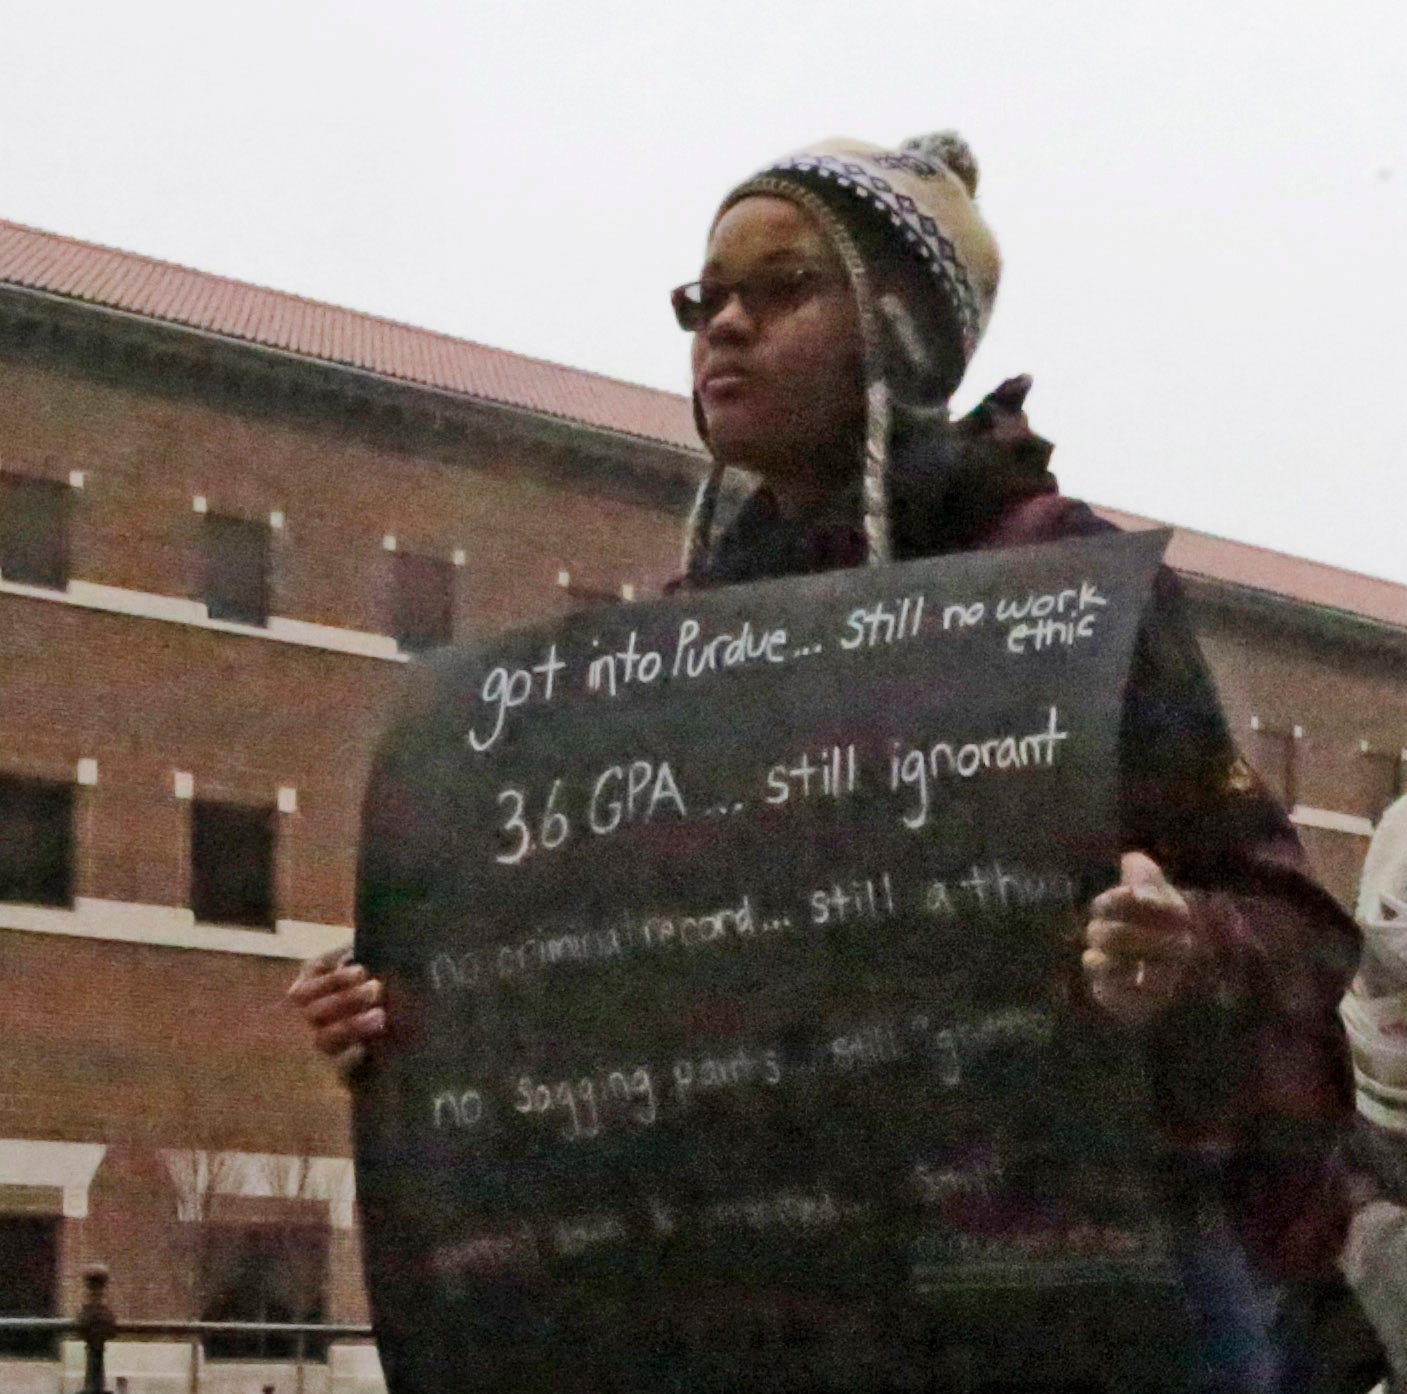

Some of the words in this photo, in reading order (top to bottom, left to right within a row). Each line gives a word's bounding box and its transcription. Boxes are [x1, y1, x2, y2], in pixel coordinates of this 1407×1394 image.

[469, 644, 566, 751] got
[587, 630, 662, 697] into
[841, 596, 925, 650] still
[943, 602, 985, 631] no
[996, 579, 1107, 619] work
[1007, 611, 1095, 654] ethic
[496, 779, 570, 865] 3.6
[766, 744, 855, 804] still
[891, 705, 1067, 830] ignorant
[430, 952, 481, 992] no
[810, 871, 895, 924] still
[925, 880, 955, 916] a
[432, 1088, 483, 1127] no
